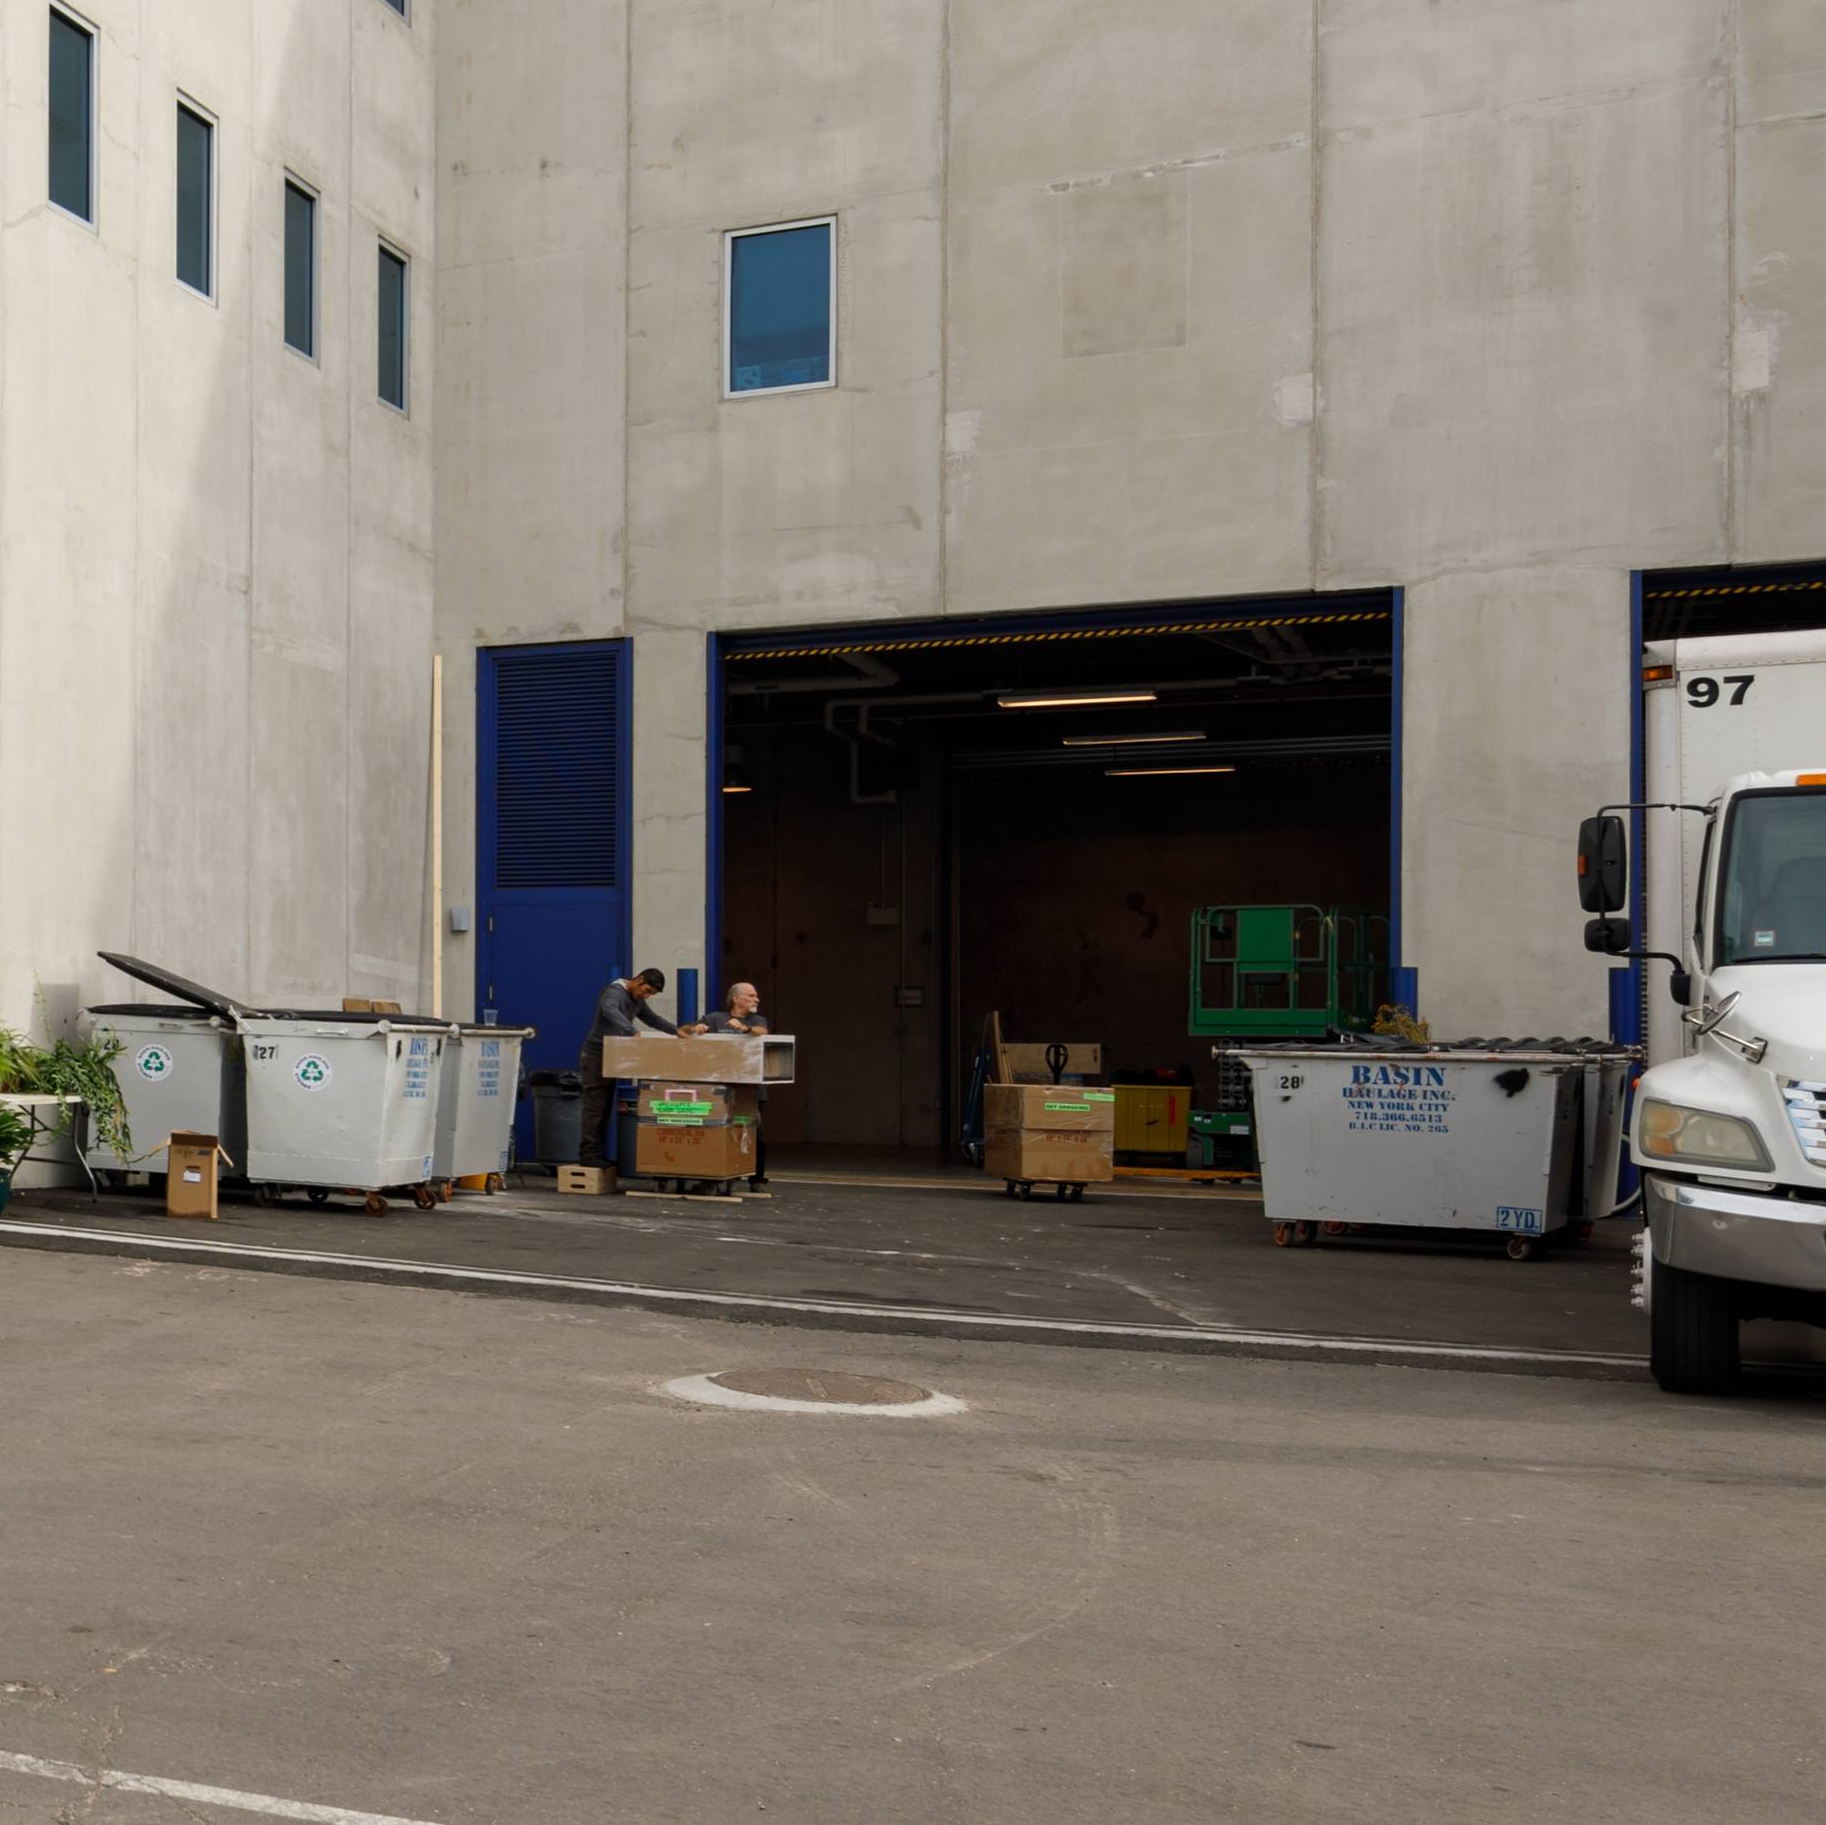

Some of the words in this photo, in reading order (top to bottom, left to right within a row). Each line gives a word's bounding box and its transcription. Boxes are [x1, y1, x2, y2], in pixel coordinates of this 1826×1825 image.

[1686, 675, 1755, 708] 97
[259, 1046, 275, 1060] 27
[1351, 1064, 1447, 1086] BASIN
[1280, 1075, 1300, 1090] 28
[1341, 1087, 1418, 1101] HAULAGE
[1422, 1089, 1456, 1101] INC.
[1347, 1100, 1374, 1110] NEW
[1379, 1102, 1415, 1112] YORK
[1419, 1103, 1450, 1112] CITY
[1404, 1124, 1424, 1132] NO.
[1500, 1209, 1510, 1227] 2
[1514, 1210, 1539, 1230] YD.
